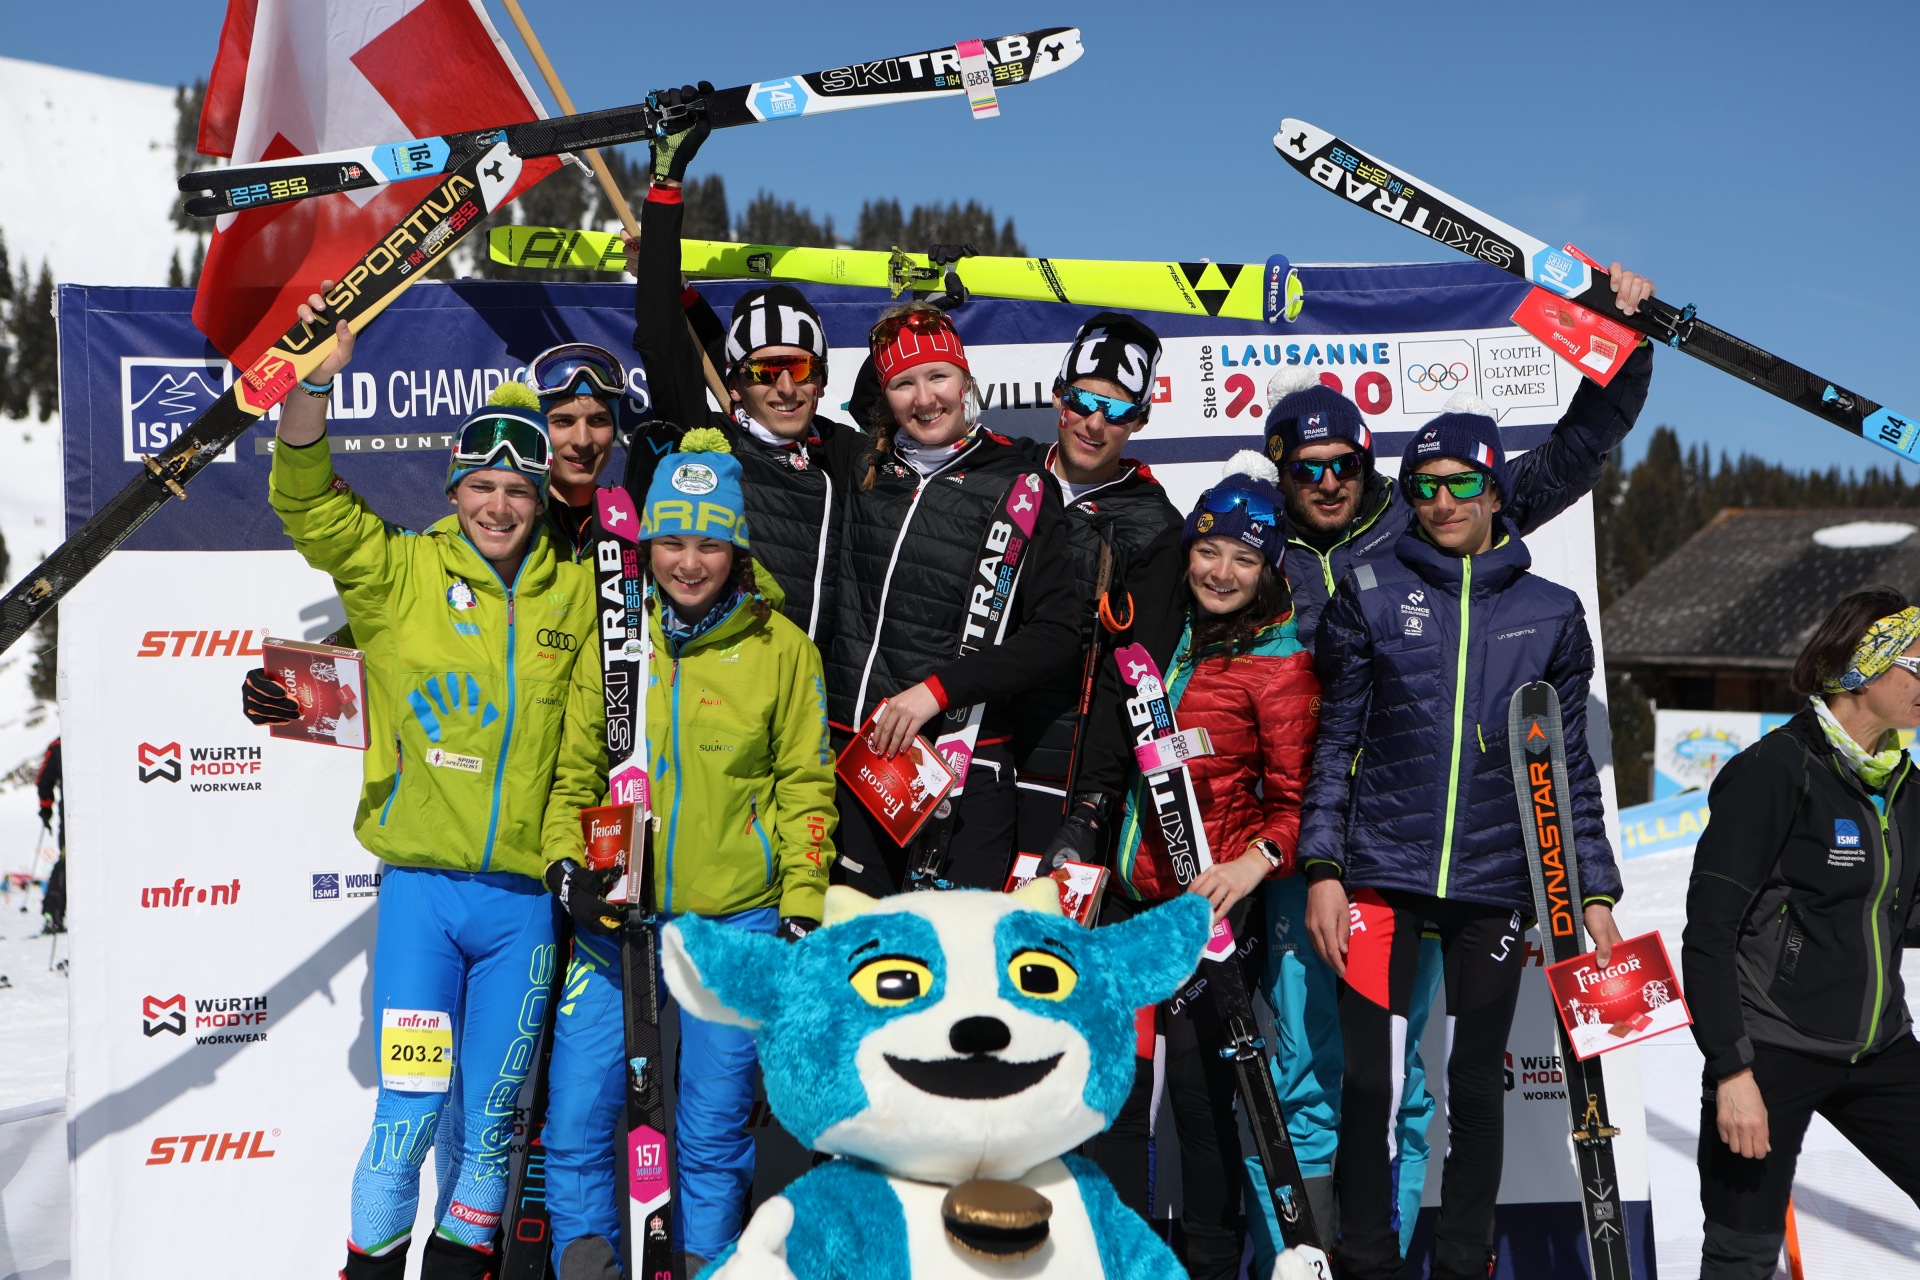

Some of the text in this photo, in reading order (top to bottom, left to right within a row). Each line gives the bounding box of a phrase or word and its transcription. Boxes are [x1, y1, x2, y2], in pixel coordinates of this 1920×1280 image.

[945, 75, 961, 86] 164
[771, 100, 797, 112] LAYERS
[407, 142, 434, 172] 164
[1329, 146, 1346, 165] GA
[1341, 154, 1360, 172] RA
[1356, 162, 1374, 179] AE
[1369, 168, 1388, 186] RO
[249, 183, 270, 202] AE
[269, 179, 290, 199] RA
[288, 176, 309, 195] GA
[230, 186, 251, 206] RO
[325, 174, 476, 315] SPORTIVA
[397, 249, 425, 275] 164 70
[1545, 254, 1574, 273] LAYERS
[1539, 263, 1572, 289] 14
[1166, 264, 1197, 310] FISCHER
[1553, 330, 1581, 356] FRIGOR
[1221, 342, 1391, 367] LAUSANNE
[1488, 346, 1543, 361] YOUTH
[1484, 363, 1551, 380] OLYMPIC
[1199, 345, 1218, 419] Site hôte
[1491, 382, 1546, 397] GAMES
[976, 382, 1053, 411] VILL
[1304, 427, 1328, 436] FRANCE
[1878, 415, 1907, 445] 164
[1418, 441, 1440, 450] FRANCE
[1008, 537, 1023, 552] GA
[1243, 531, 1265, 546] FRANCE
[623, 549, 637, 563] GA
[1003, 551, 1018, 566] RA
[624, 564, 638, 578] RA
[1000, 565, 1014, 580] AE
[625, 579, 638, 594] AE
[996, 580, 1010, 595] RO
[626, 595, 640, 609] RO
[992, 597, 1004, 609] 157
[1401, 604, 1430, 613] FRANCE
[627, 614, 638, 626] 157
[989, 611, 1000, 621] 60
[627, 628, 637, 638] 60
[1506, 628, 1538, 639] SPORTIVA
[136, 630, 263, 657] STIHL
[597, 540, 631, 751] SKITRAB
[537, 651, 557, 660] Audi
[536, 697, 563, 707] SUUNTO
[700, 697, 722, 706] Audi
[1150, 699, 1166, 715] GA
[1154, 713, 1170, 729] RA
[1171, 735, 1185, 744] PO
[1173, 742, 1187, 751] MO
[699, 743, 735, 752] SUUNTO
[1175, 748, 1189, 759] CA
[445, 760, 479, 770] SPECIALIST
[457, 756, 480, 765] SPORT
[190, 762, 262, 776] MODYF
[190, 782, 262, 793] WORKWEAR
[614, 778, 635, 805] 14
[633, 778, 644, 803] LAYERS
[860, 764, 905, 820] FRIGOR
[1126, 697, 1195, 886] SKITAB
[591, 818, 622, 844] FRIGOR
[806, 815, 825, 868] Audi
[1837, 835, 1859, 845] ISMF
[1530, 761, 1574, 937] DYNASTAR
[1827, 859, 1854, 867] Federation
[1829, 854, 1866, 863] Mountaineering
[345, 873, 382, 888] WORLD
[314, 889, 338, 898] ISMF
[1490, 935, 1515, 962] LA
[1573, 957, 1642, 994] FRIGOR
[1170, 997, 1187, 1015] LA
[195, 1012, 267, 1028] MODYF
[195, 1032, 268, 1046] WORKWEAR
[391, 1044, 443, 1063] 203.2
[1522, 1070, 1563, 1084] MOD
[1523, 1091, 1567, 1101] WORKW
[145, 1130, 276, 1166] STIHL
[635, 1143, 661, 1167] 157
[466, 1209, 501, 1228] ENERVIT
